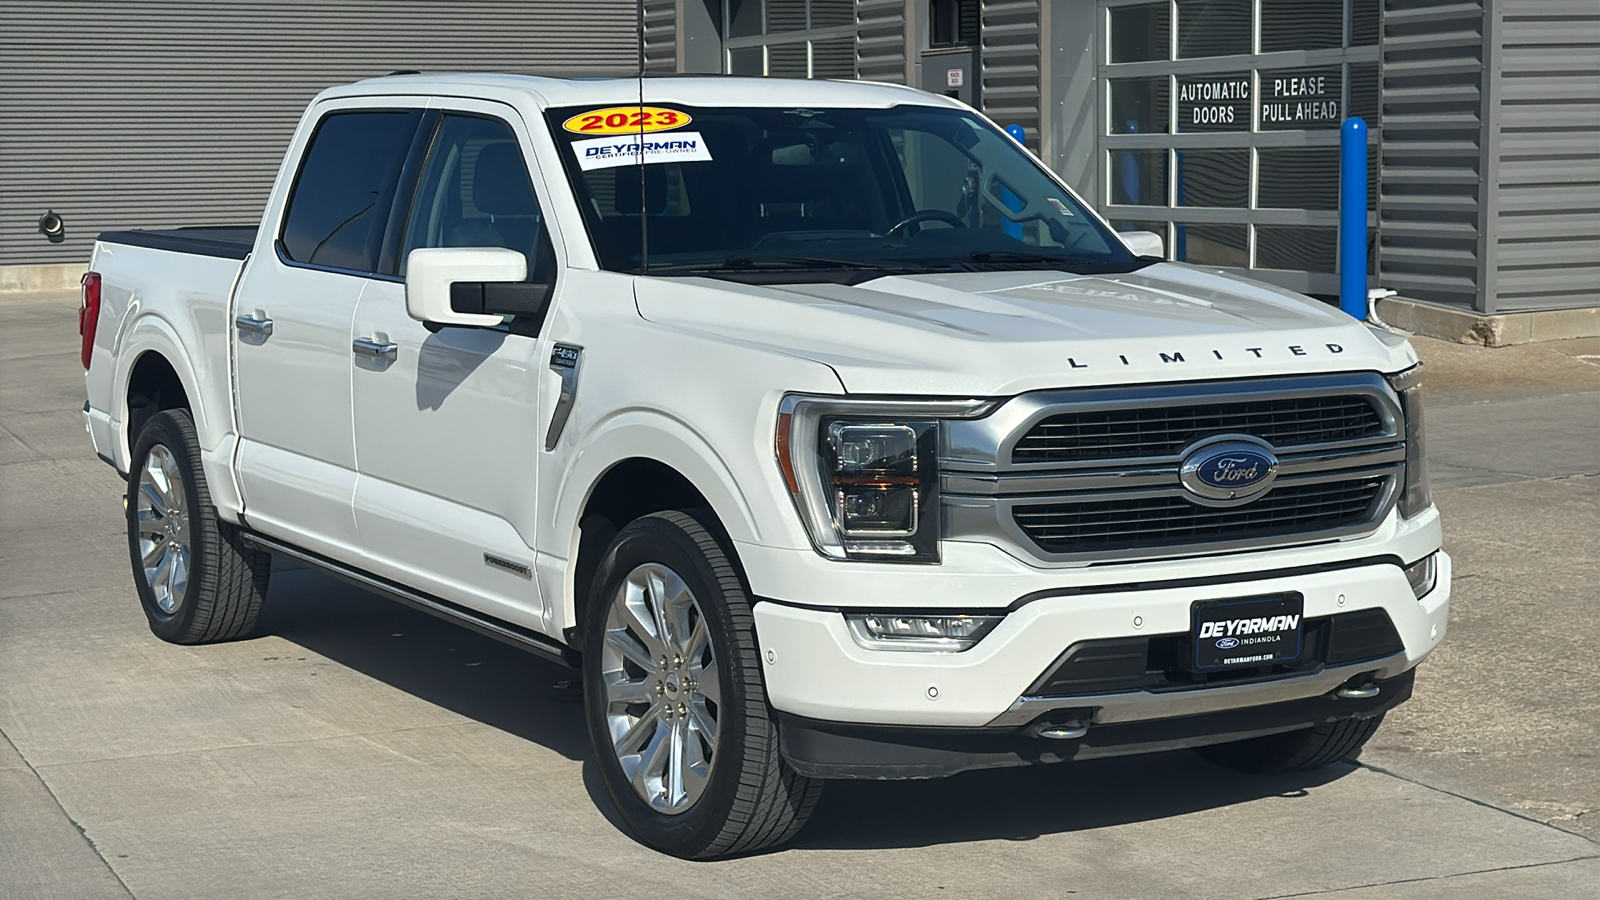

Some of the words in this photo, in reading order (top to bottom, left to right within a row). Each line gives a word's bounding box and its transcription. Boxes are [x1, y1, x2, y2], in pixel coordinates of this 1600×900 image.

[1180, 81, 1249, 101] AUTOMATIC
[1274, 76, 1326, 97] PLEASE
[580, 111, 678, 130] 2023
[1193, 105, 1235, 124] DOORS
[1262, 103, 1292, 122] PULL
[1295, 101, 1338, 121] AHEAD
[585, 140, 696, 156] DEYARMAN
[1067, 343, 1344, 368] LIMITED
[1213, 457, 1259, 482] Ford
[1199, 614, 1299, 638] DEYARMAN
[1241, 635, 1281, 645] INDIANOLA
